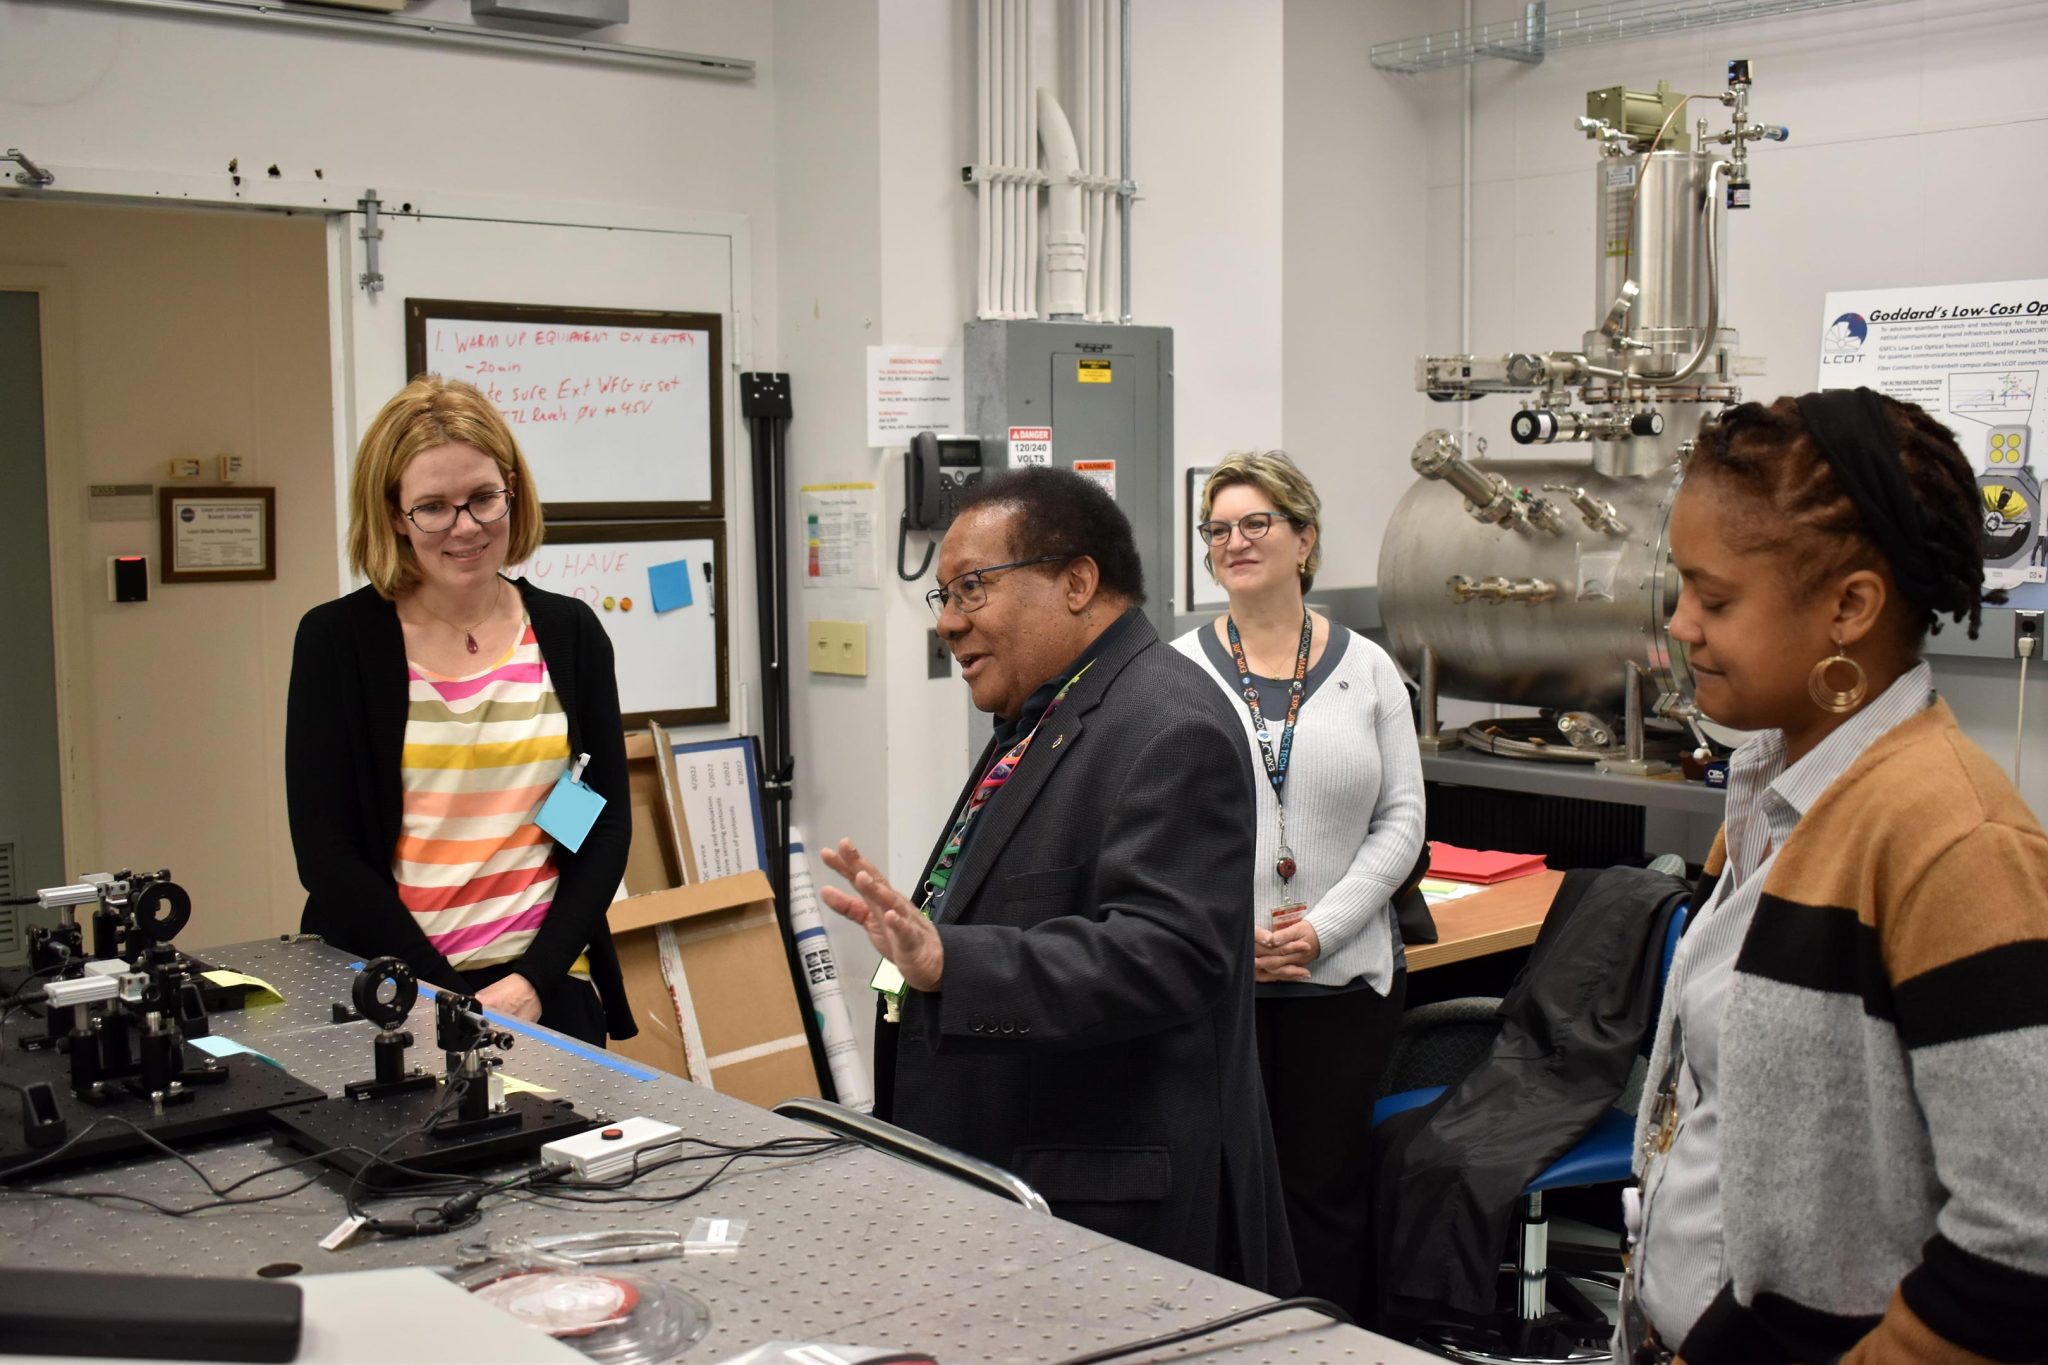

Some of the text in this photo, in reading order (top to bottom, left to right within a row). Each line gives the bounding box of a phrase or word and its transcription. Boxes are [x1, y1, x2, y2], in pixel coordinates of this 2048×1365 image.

[1869, 305, 1948, 322] Goddard's
[1952, 302, 2022, 318] Low-Cost
[455, 332, 499, 353] WARM
[506, 331, 527, 347] UP
[619, 332, 643, 343] ON
[650, 333, 695, 347] ENTRY
[1823, 353, 1866, 365] LCOT
[512, 384, 548, 402] sure
[658, 377, 681, 393] set
[1020, 430, 1049, 440] DANGER
[1015, 443, 1048, 452] 120/240
[1017, 454, 1046, 463] VOLTS
[561, 551, 630, 579] HAVE
[1278, 694, 1300, 771] EXPLOR PACE TECH
